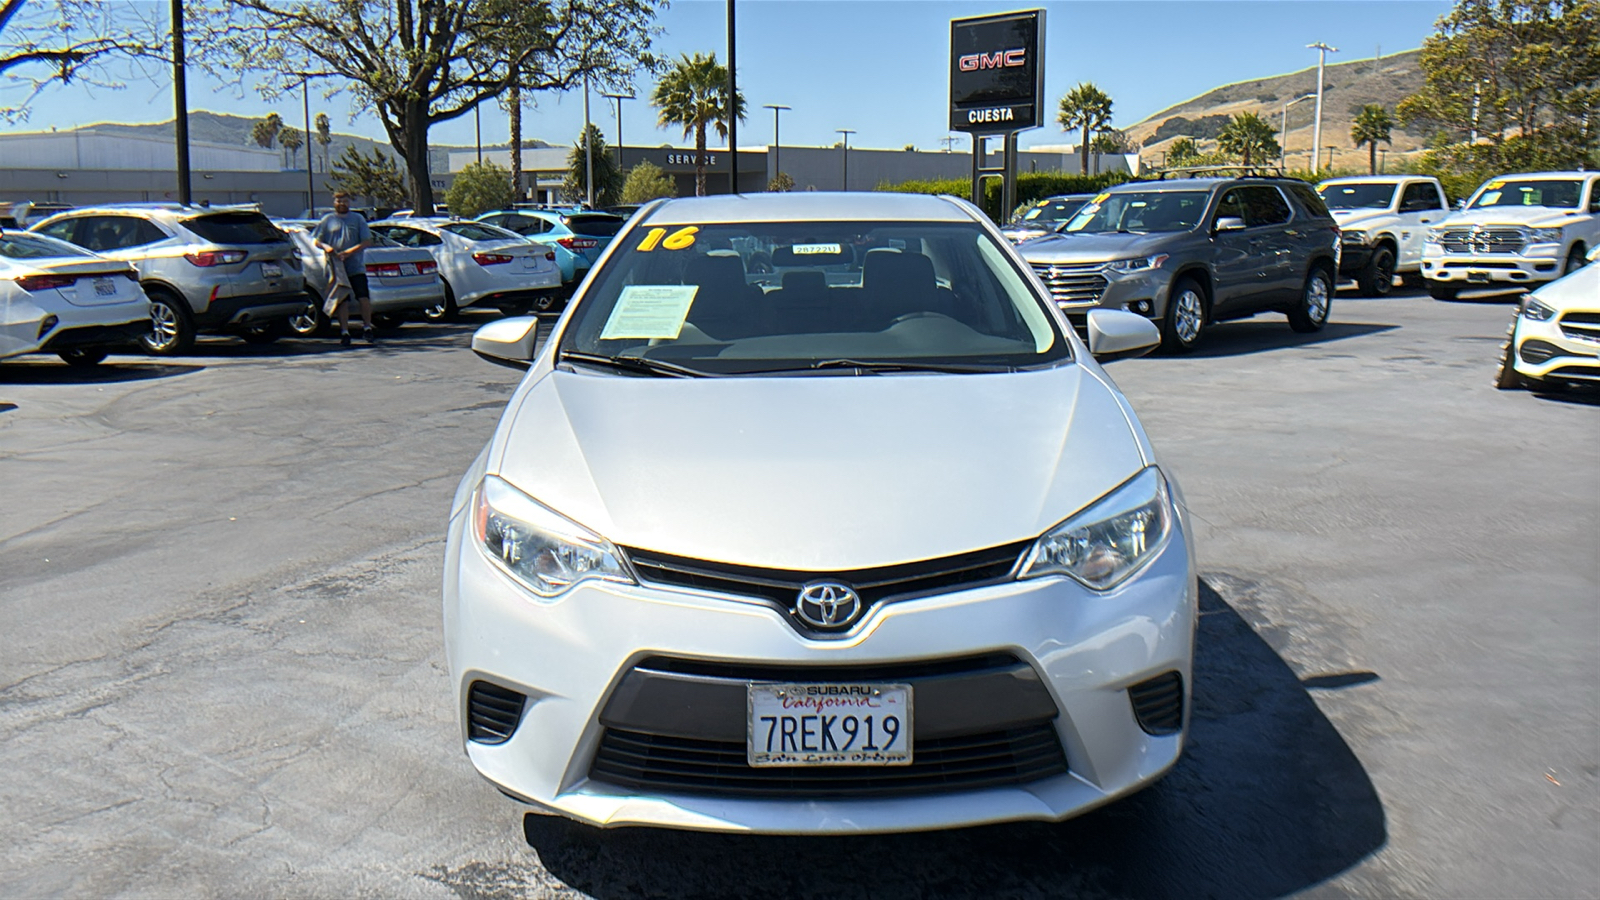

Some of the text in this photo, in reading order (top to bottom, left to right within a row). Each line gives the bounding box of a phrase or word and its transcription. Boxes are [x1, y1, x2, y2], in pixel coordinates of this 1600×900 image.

[959, 47, 1026, 72] GMC
[968, 107, 1014, 123] CUESTA
[668, 154, 716, 165] SERVCE
[431, 180, 446, 188] RTS
[636, 226, 699, 252] 16
[807, 686, 871, 696] SUBARU
[782, 696, 881, 714] California
[760, 715, 900, 752] 7REK919
[755, 753, 799, 763] San
[802, 752, 846, 763] Luis
